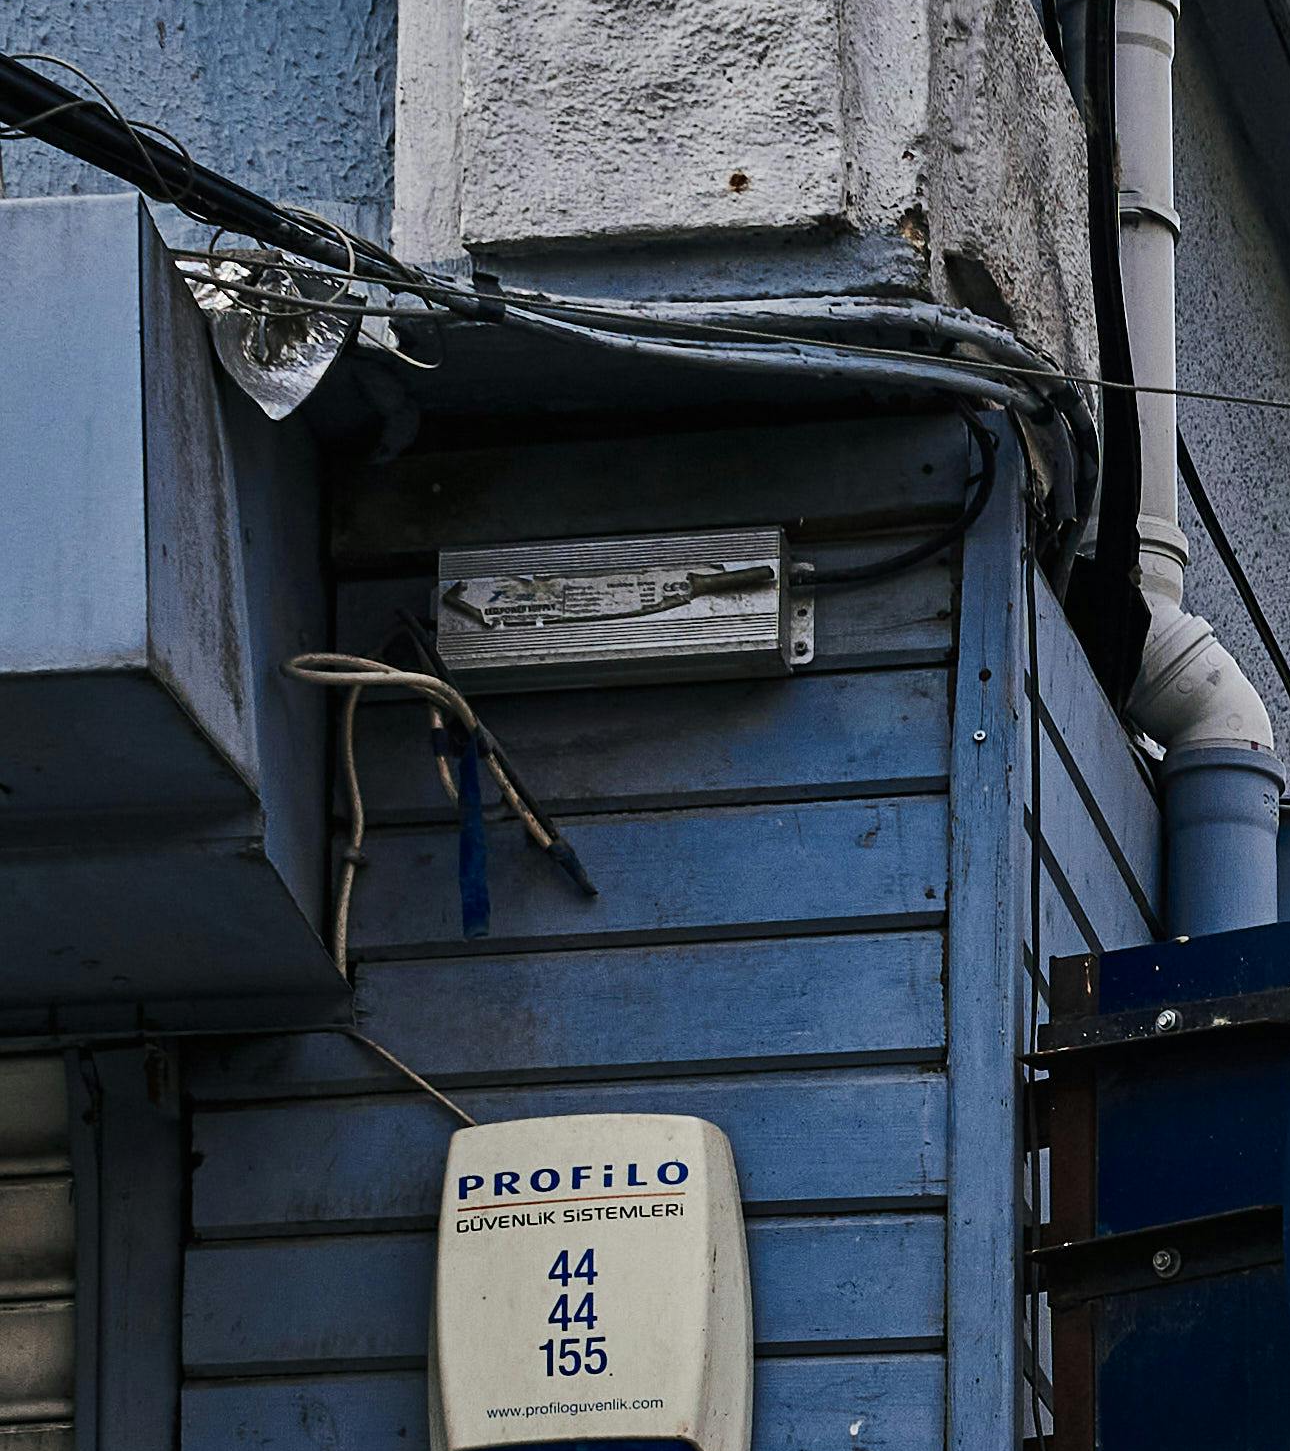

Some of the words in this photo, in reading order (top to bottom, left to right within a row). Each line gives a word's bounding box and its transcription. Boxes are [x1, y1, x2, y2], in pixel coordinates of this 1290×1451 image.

[548, 1248, 598, 1287] 44
[548, 1292, 598, 1331] 44
[538, 1336, 608, 1377] 155
[486, 1398, 664, 1419] www.profiloguvenlik.com
